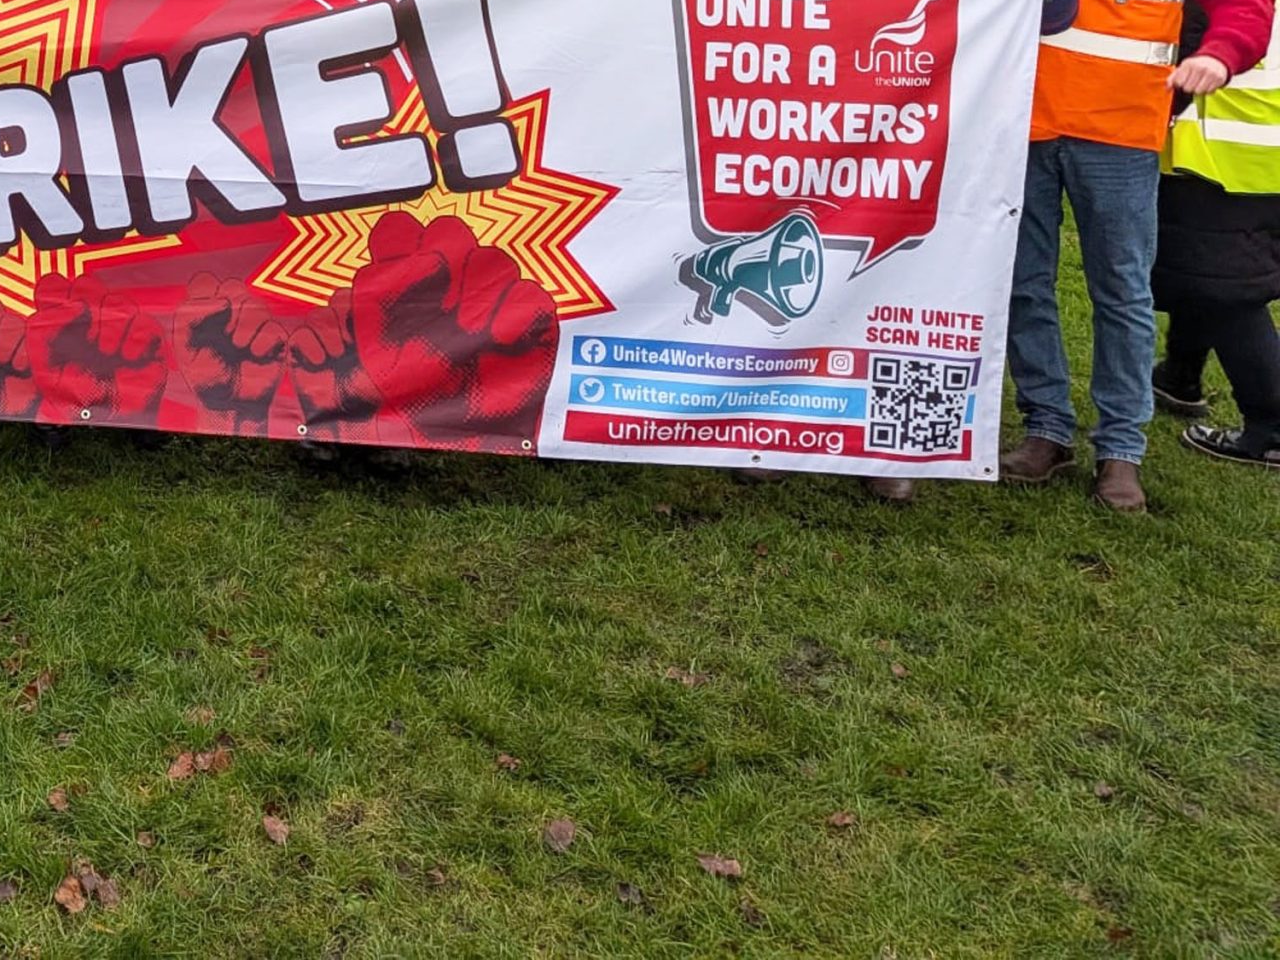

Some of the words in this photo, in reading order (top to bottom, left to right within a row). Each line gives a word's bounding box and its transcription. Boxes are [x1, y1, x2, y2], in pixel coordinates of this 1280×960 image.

[704, 41, 791, 84] FOR
[808, 45, 836, 86] A
[855, 47, 935, 73] unite
[714, 153, 933, 199] ECONOMY
[867, 305, 913, 325] JOIN
[921, 309, 984, 331] UNITE
[866, 326, 919, 347] SCAN
[927, 333, 982, 352] HERE
[613, 344, 819, 373] Unite4WorkersEconomy
[612, 383, 848, 413] Twitter.com/UniteEconomy
[608, 418, 845, 455] unitetheunion.org
